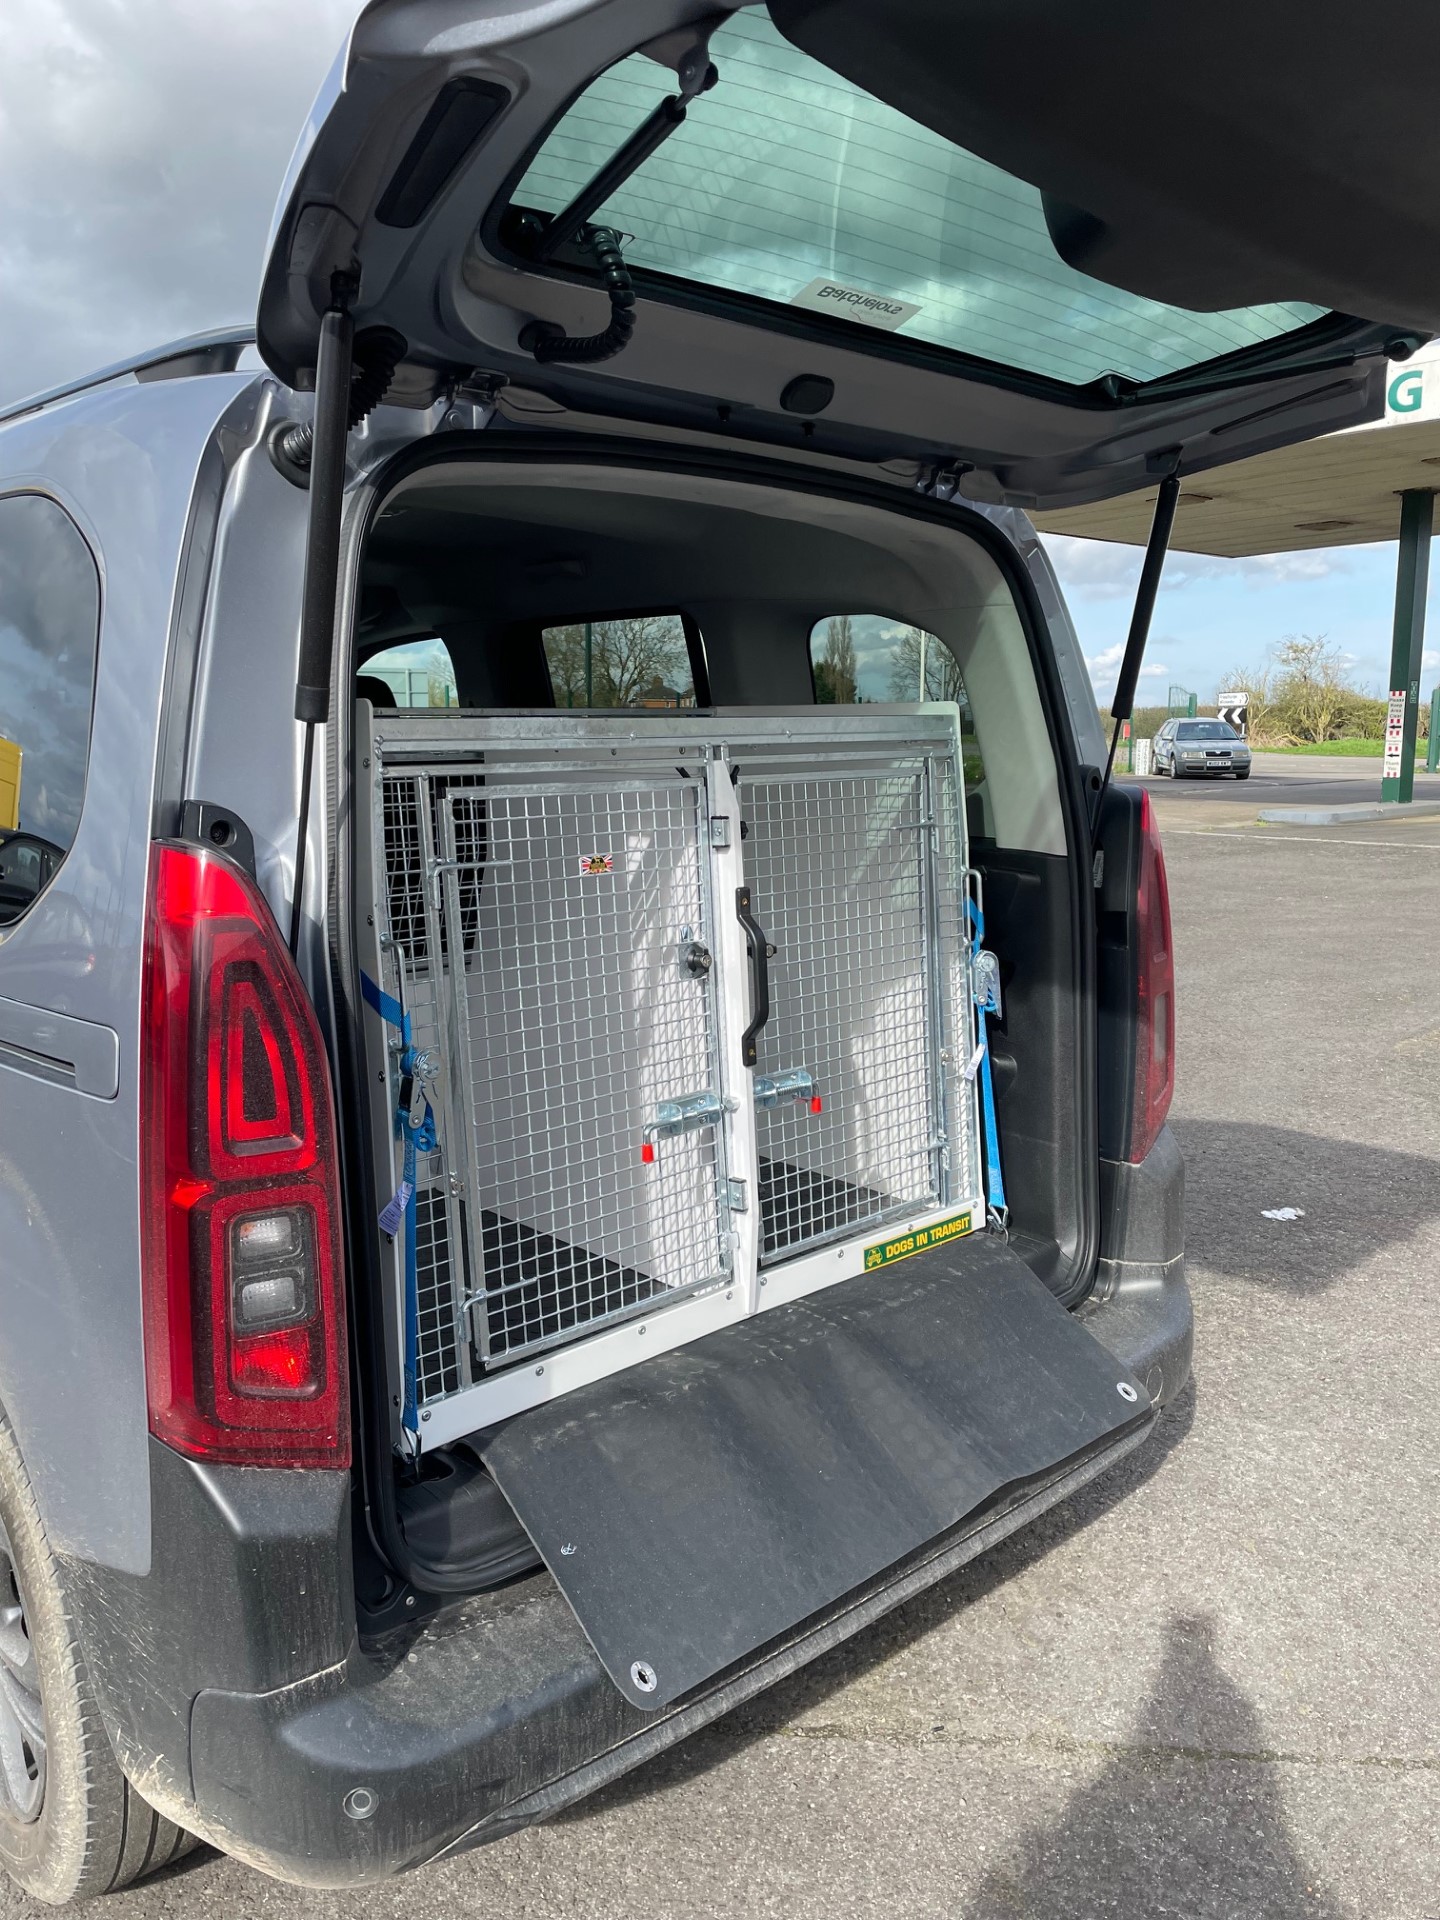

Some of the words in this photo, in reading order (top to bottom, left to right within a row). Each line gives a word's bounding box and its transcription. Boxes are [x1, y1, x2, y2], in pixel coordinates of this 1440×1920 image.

[1388, 370, 1423, 412] G
[886, 1238, 914, 1258] DOGS
[916, 1232, 928, 1247] IN
[930, 1216, 970, 1241] TRANSIT
